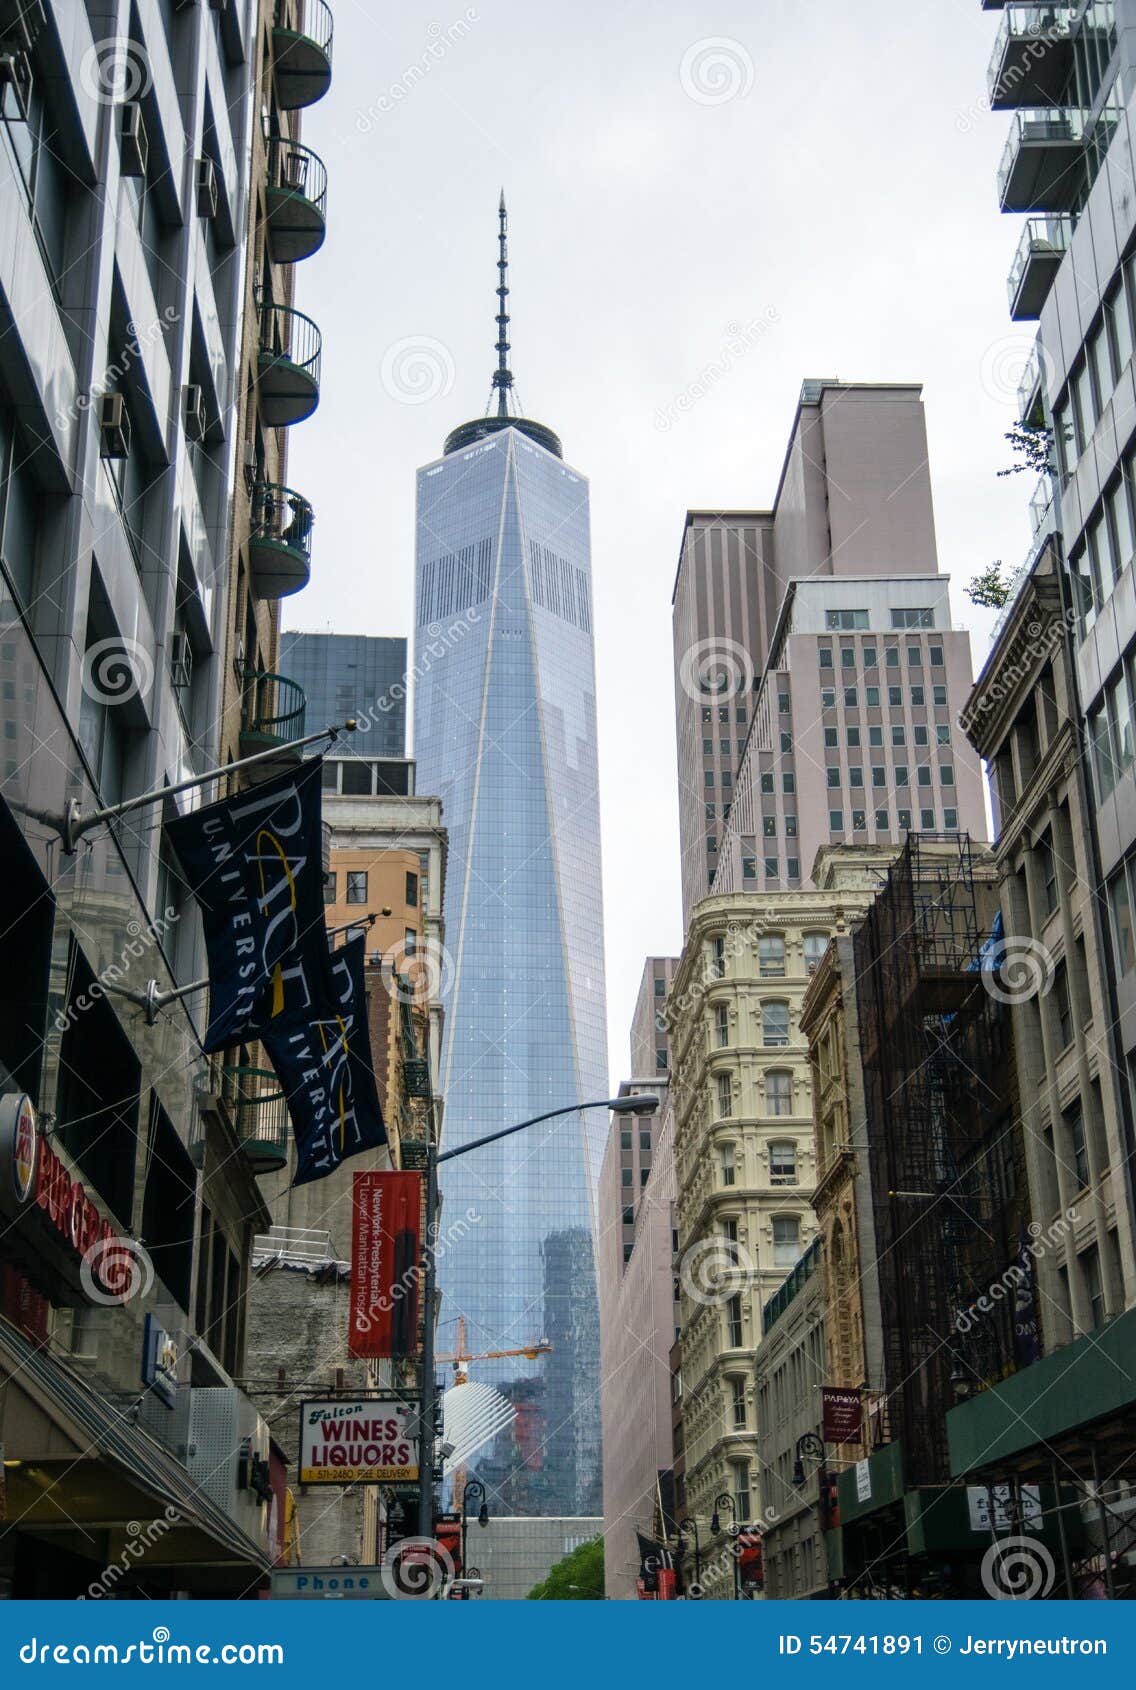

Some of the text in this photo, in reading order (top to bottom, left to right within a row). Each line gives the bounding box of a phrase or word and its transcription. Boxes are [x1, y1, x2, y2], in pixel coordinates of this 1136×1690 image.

[356, 1223, 370, 1284] Manhattan
[309, 1405, 363, 1425] Fulton
[321, 1419, 398, 1441] WINES
[311, 1443, 410, 1467] LIQUORS
[296, 1576, 370, 1590] Phone
